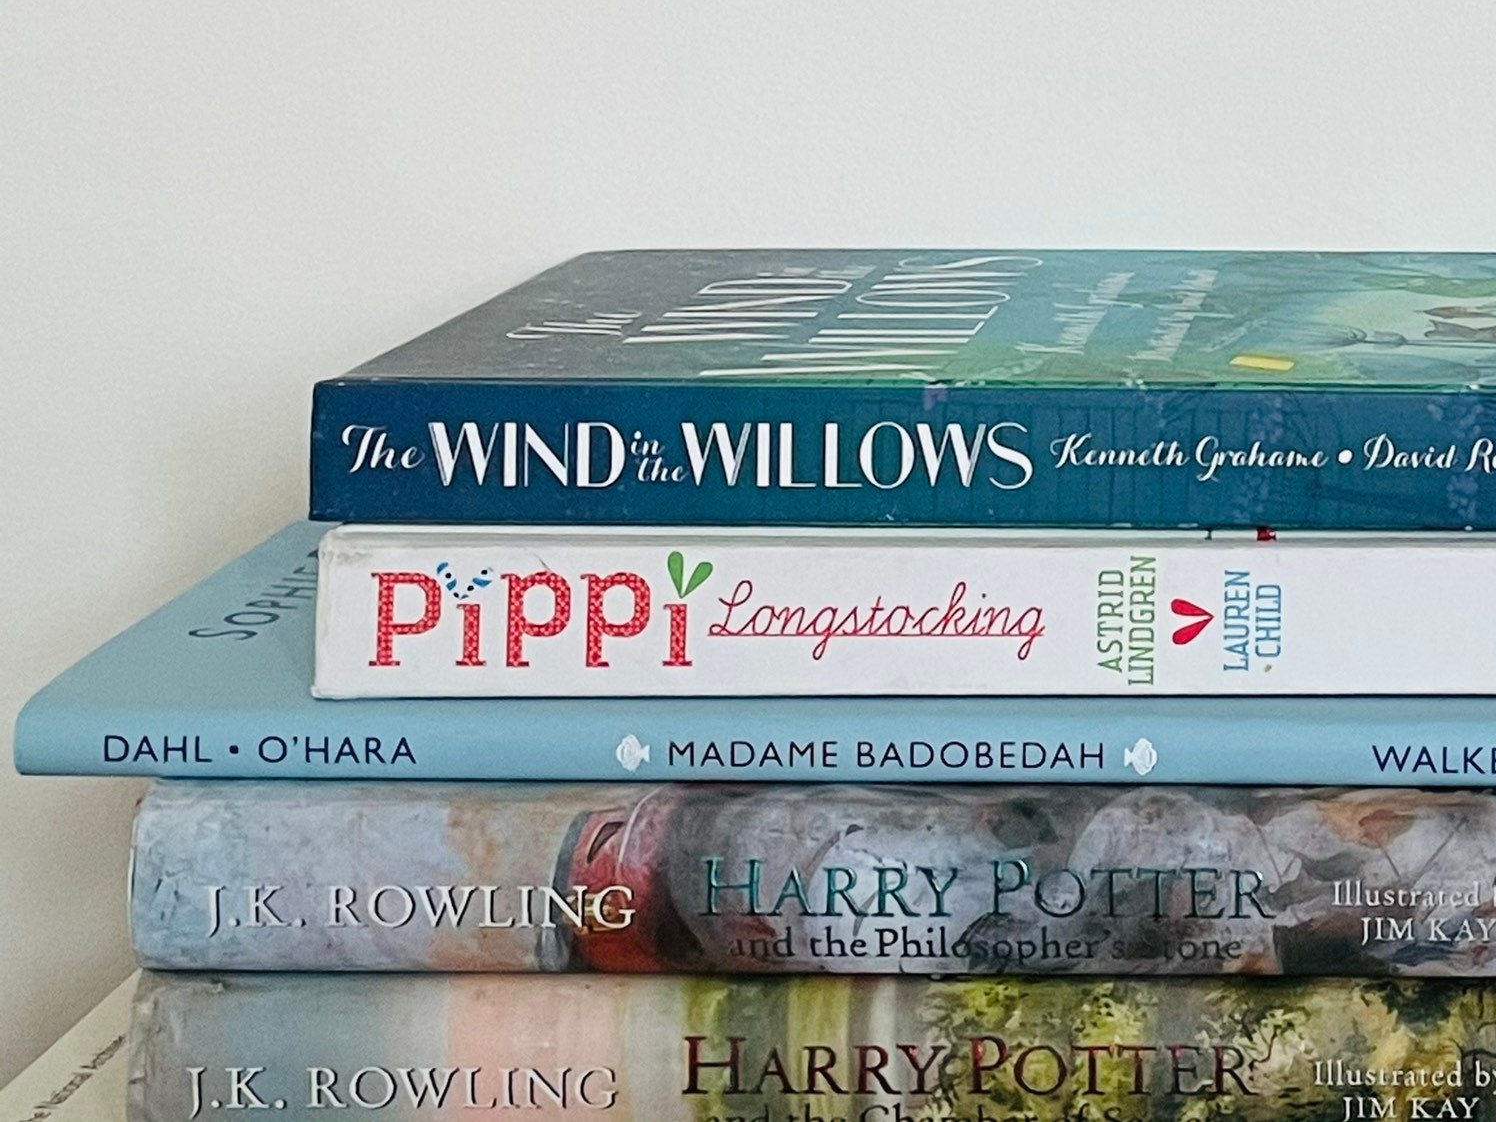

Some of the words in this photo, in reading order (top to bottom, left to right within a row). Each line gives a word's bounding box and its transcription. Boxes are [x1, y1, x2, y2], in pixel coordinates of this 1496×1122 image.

[341, 424, 426, 474] The
[427, 421, 627, 488] WIND
[629, 429, 666, 457] in
[680, 421, 1034, 491] WILLOWS
[1050, 432, 1190, 469] Kenneth
[1195, 435, 1330, 483] Grahame
[1362, 433, 1459, 471] David
[634, 456, 689, 484] the
[368, 554, 700, 668] Pippi
[706, 579, 1046, 661] Longstocking
[1096, 568, 1124, 673] ASTRID
[1128, 555, 1157, 687] LINDGREN
[1223, 569, 1251, 672] LAUREN
[1255, 583, 1282, 658] CHILD
[103, 734, 212, 764] DAHL
[257, 734, 418, 765] O'HARA
[667, 739, 839, 769] MADAME
[855, 740, 1105, 771] BADOBEDAH
[206, 884, 306, 939] J.K.
[325, 883, 637, 930] ROWLING
[699, 856, 960, 919] HARRY
[993, 857, 1277, 920] POTTER
[1331, 880, 1480, 908] Illustrated
[729, 925, 795, 960] and
[809, 925, 867, 959] the
[874, 926, 1126, 966] Philosopher's
[1360, 916, 1415, 946] JIM
[681, 1034, 947, 1096] HARRY
[966, 1035, 1260, 1098] POTTER
[1313, 1059, 1463, 1088] Illustrated
[186, 1066, 287, 1120] J.K.
[306, 1066, 618, 1110] ROWLING
[1342, 1096, 1398, 1122] JIM
[1409, 1096, 1481, 1120] KAY
